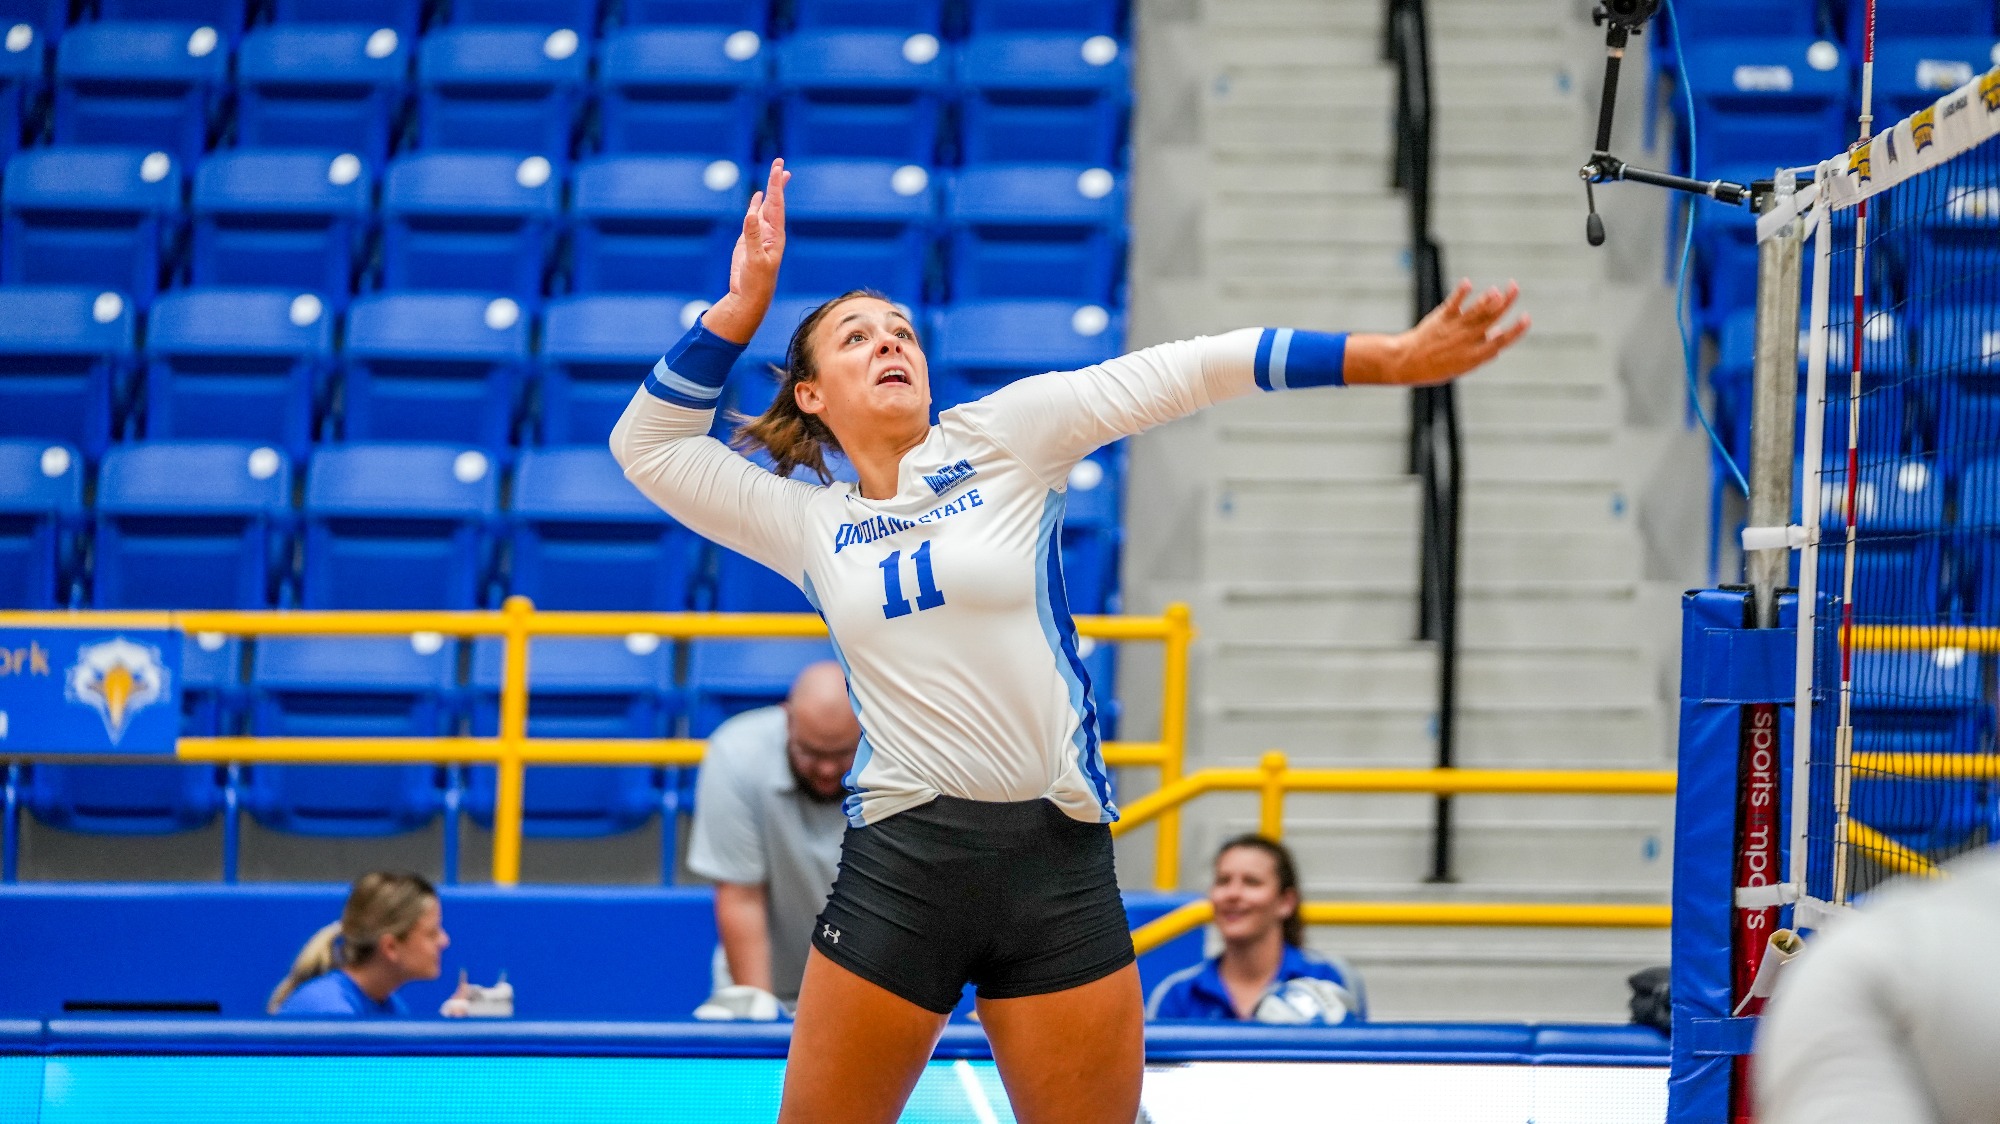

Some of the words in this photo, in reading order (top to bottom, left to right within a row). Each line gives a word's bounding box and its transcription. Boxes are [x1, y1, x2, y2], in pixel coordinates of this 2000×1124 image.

[918, 488, 984, 523] STATE
[879, 540, 946, 620] 11
[1750, 711, 1774, 807] sports
